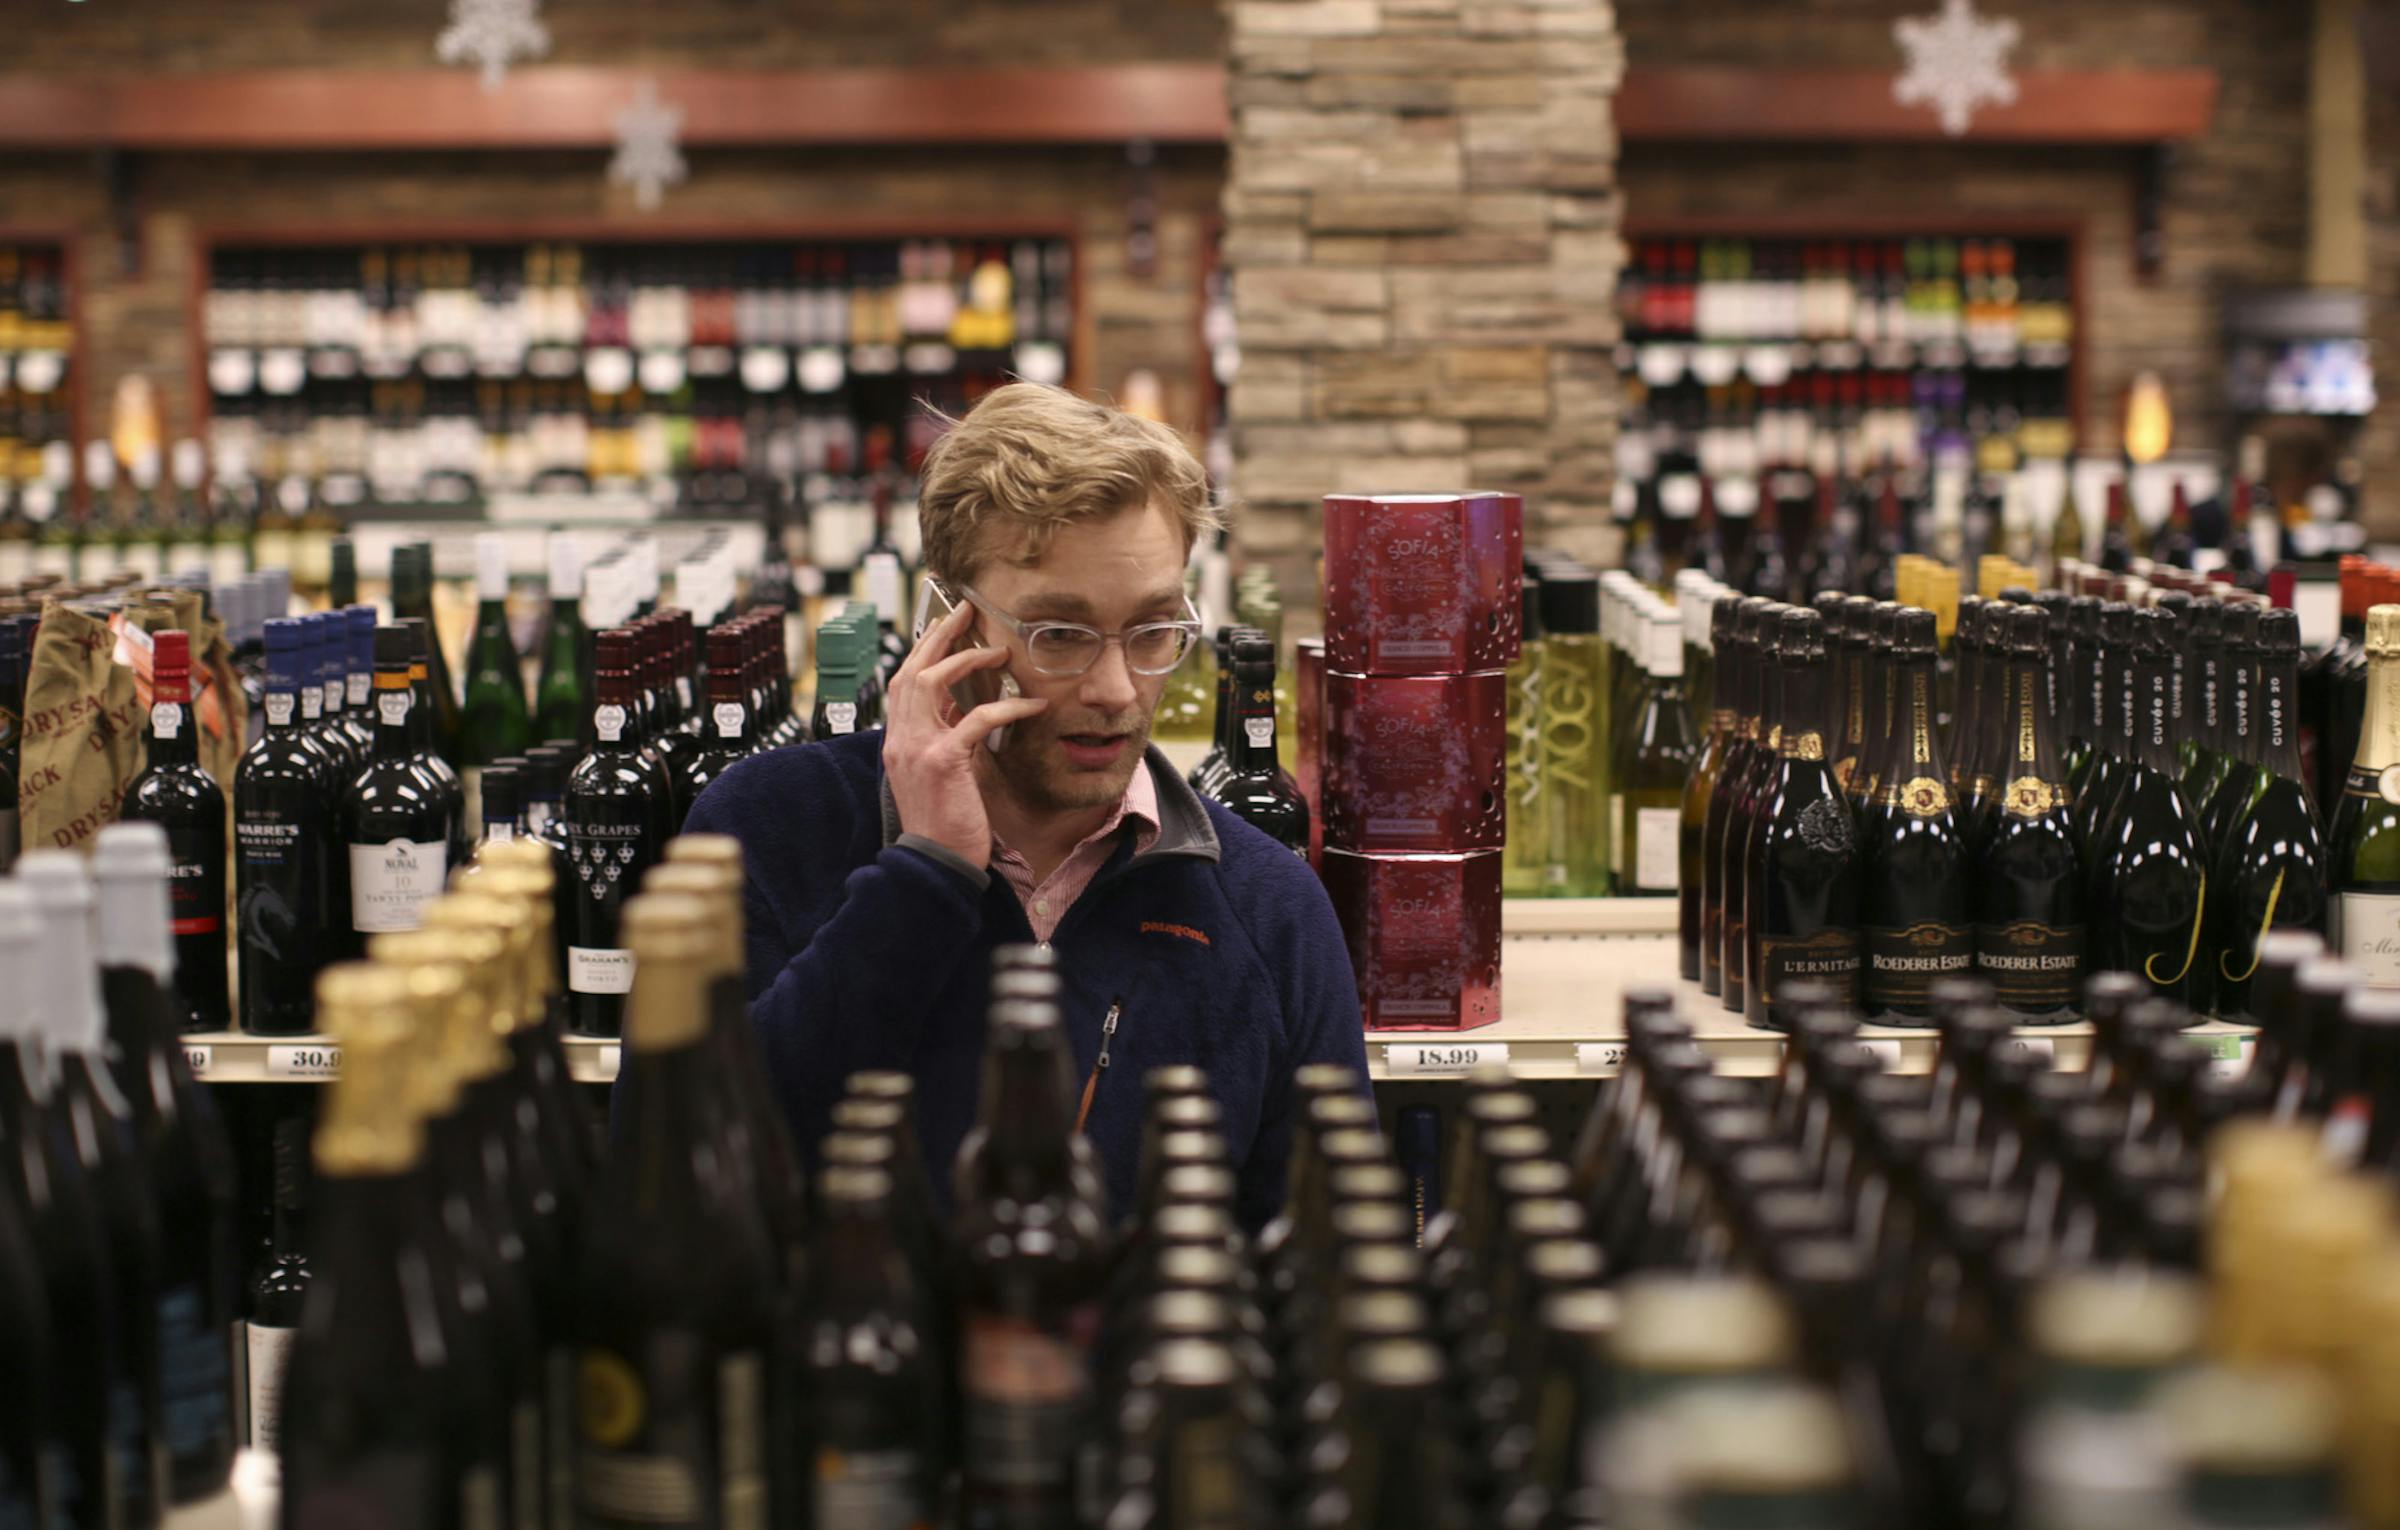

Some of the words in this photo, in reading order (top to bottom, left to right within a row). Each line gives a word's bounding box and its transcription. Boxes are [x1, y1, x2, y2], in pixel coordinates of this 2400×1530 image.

[1387, 540, 1438, 560] SOFIA
[2270, 677, 2280, 693] 20
[1376, 717, 1425, 738] SOFIA
[236, 823, 299, 837] WARRE'S
[586, 823, 641, 836] GRAPES
[1390, 899, 1441, 918] SOFIA
[1141, 921, 1210, 945] patagonia
[578, 954, 630, 964] GRAHAM'S
[1873, 954, 1939, 971] ROEDERER
[1941, 955, 1970, 970] ESTATE
[1978, 952, 2039, 971] ROEDERER
[2041, 955, 2076, 970] ESTATE
[293, 1051, 341, 1067] 30.9
[1417, 1049, 1478, 1066] 18.99
